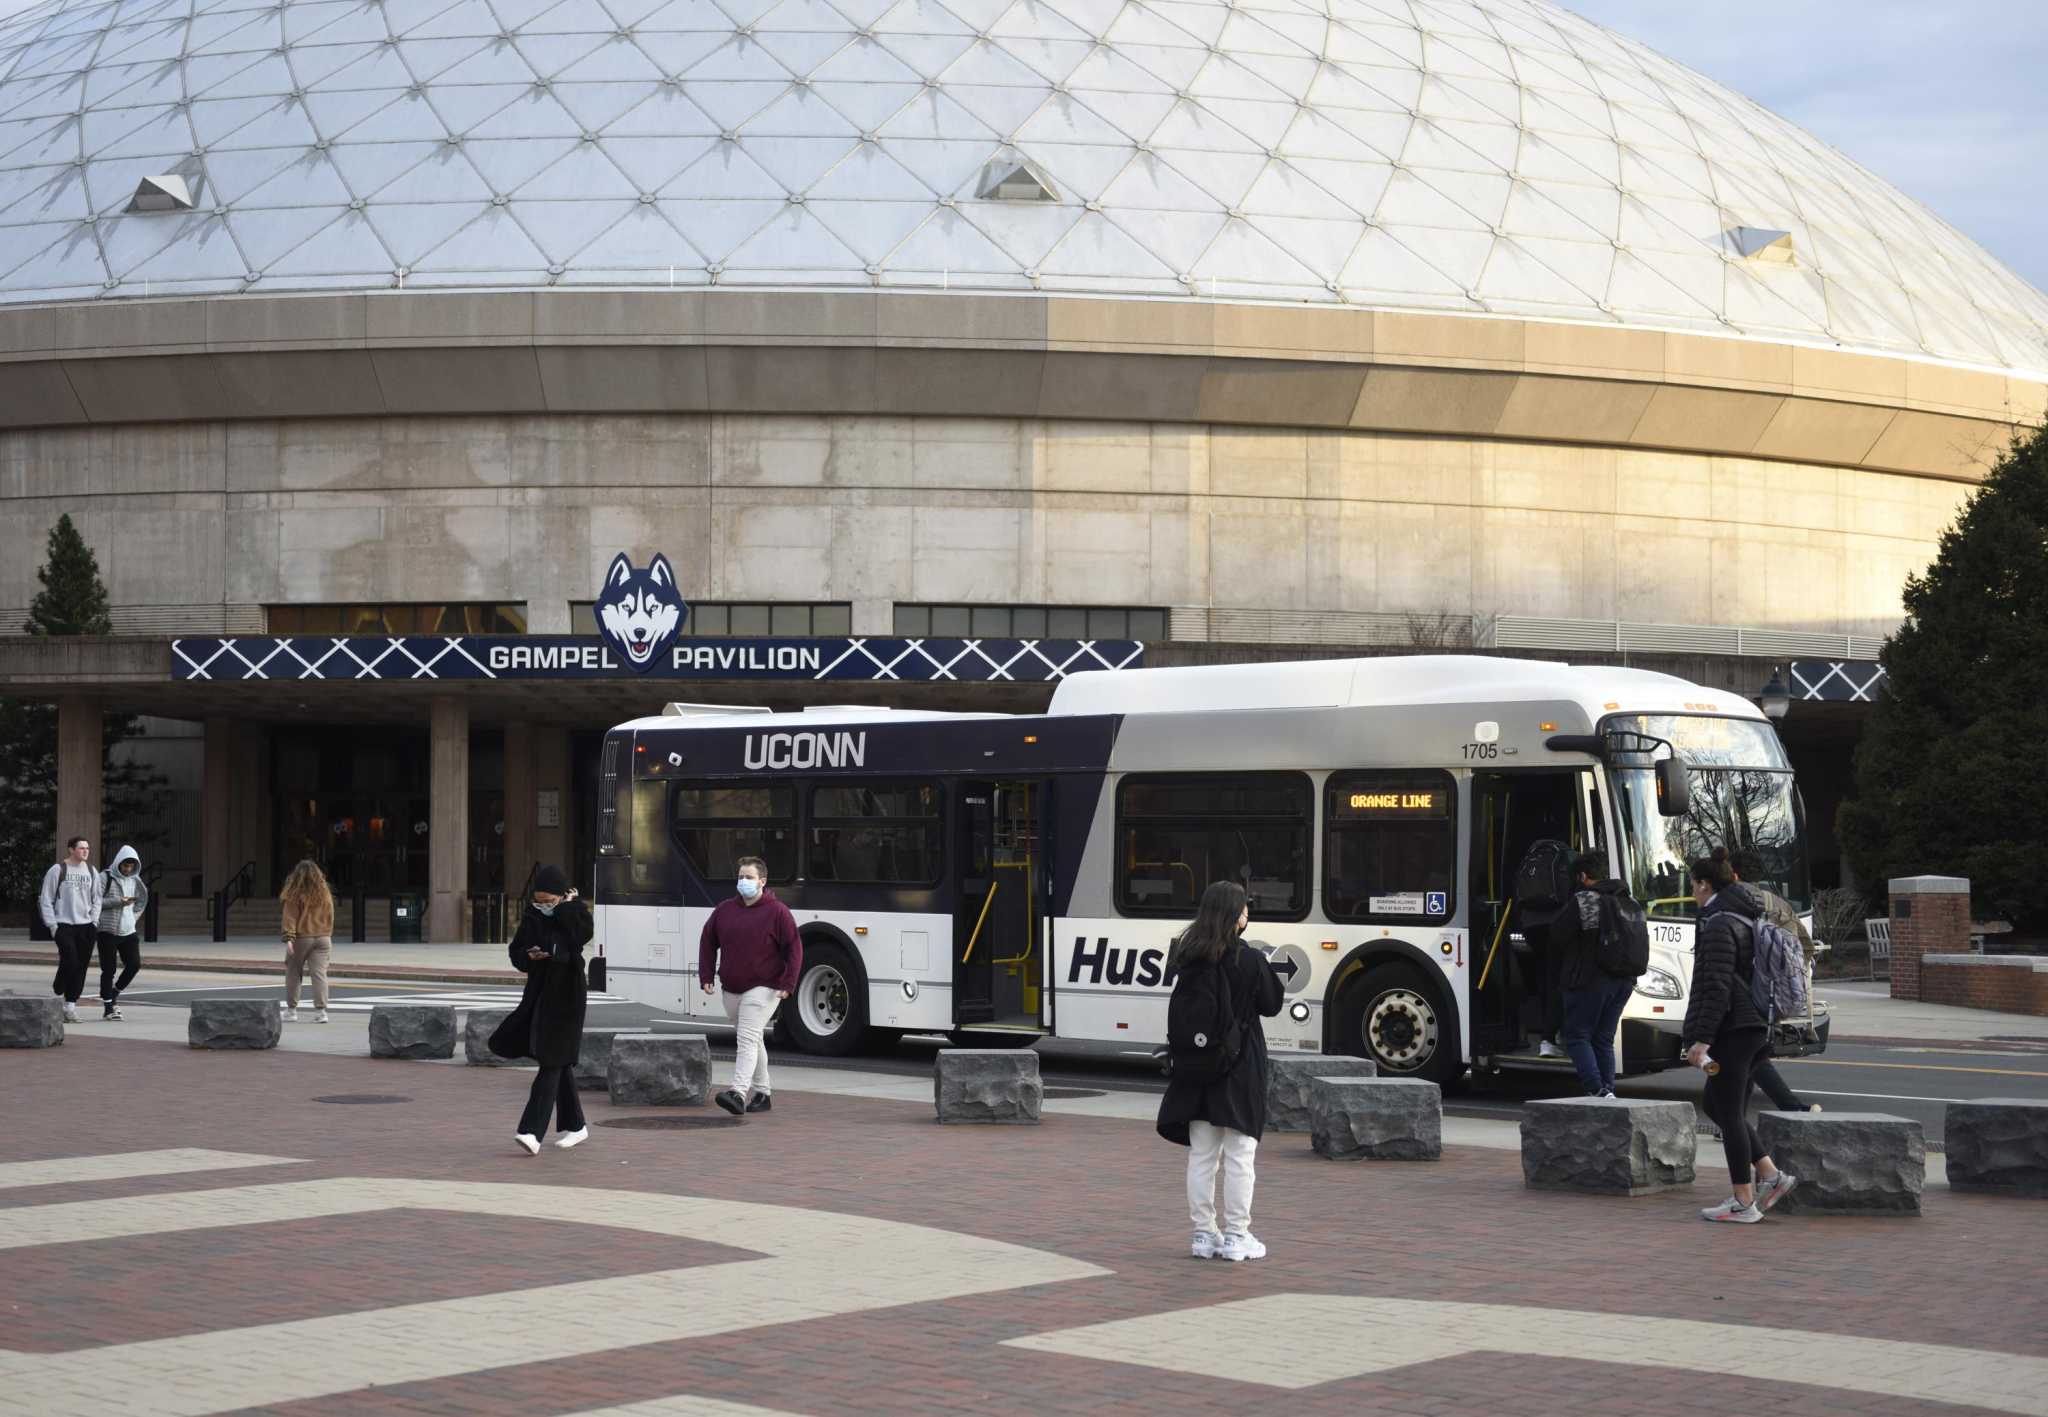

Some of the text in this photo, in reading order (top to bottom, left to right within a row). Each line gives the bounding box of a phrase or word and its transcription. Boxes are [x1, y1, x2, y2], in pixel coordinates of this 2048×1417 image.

[489, 645, 820, 670] GAMPEL PAVILION
[743, 731, 866, 770] UCONN
[1461, 743, 1498, 760] 1705
[1349, 794, 1432, 808] ORANGE LINE
[1653, 926, 1682, 943] 1705
